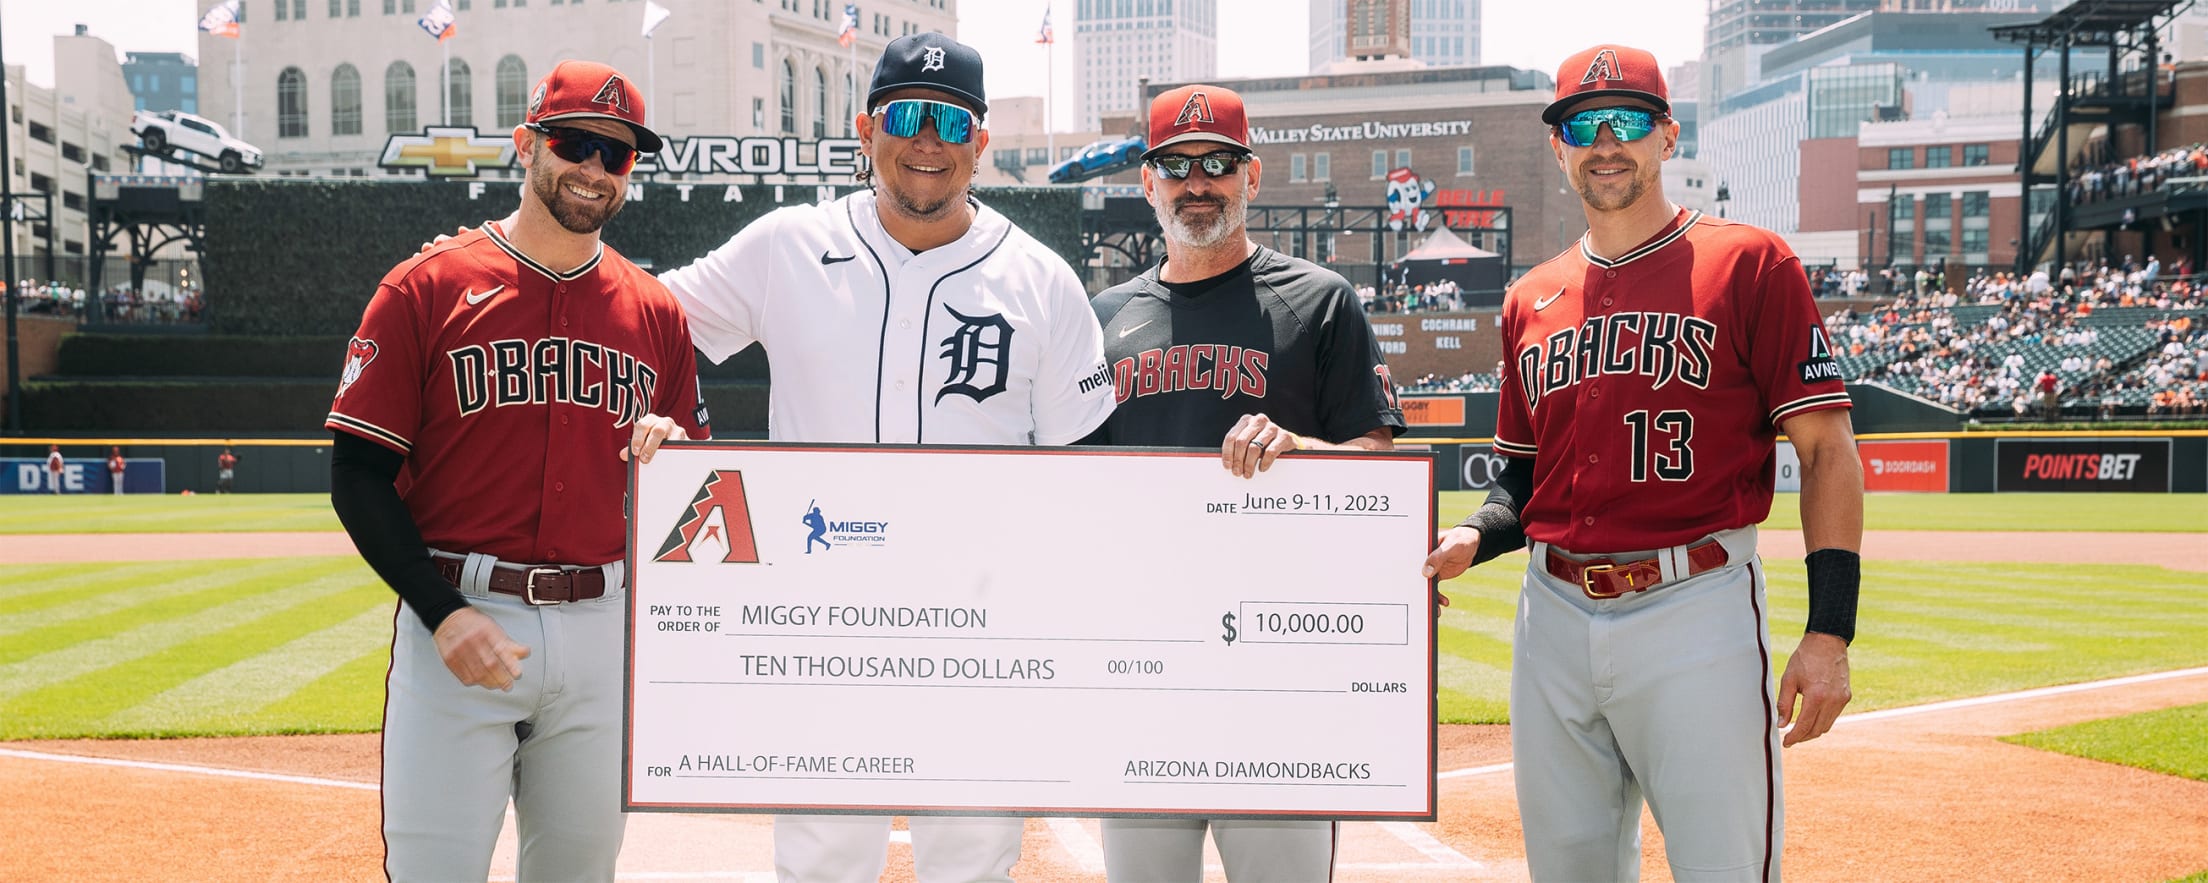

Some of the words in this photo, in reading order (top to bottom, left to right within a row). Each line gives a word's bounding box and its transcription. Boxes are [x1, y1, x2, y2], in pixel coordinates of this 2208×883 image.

[1249, 127, 1309, 144] VALLEY
[1311, 124, 1361, 142] STATE
[1363, 121, 1472, 139] UNIVERSITY
[1443, 210, 1495, 227] TIRE
[1421, 319, 1477, 331] COCHRANE
[1436, 336, 1462, 349] KELL
[1078, 363, 1112, 394] meij
[1805, 362, 1841, 380] AVNE
[1624, 409, 1695, 483] 13
[1206, 502, 1238, 514] DATE
[1241, 492, 1288, 511] June
[1292, 493, 1339, 514] 9-11,
[1343, 494, 1391, 512] 2023
[829, 520, 889, 533] MIGGY
[649, 604, 673, 617] PAY
[675, 605, 693, 617] TO
[695, 605, 721, 618] THE
[741, 604, 822, 627] MIGGY
[827, 605, 988, 629] FOUNDATION
[657, 620, 701, 633] ORDER
[704, 621, 721, 633] OF
[1221, 610, 1238, 647] $
[1255, 612, 1364, 636] 10,000.00
[739, 654, 787, 677] TEN
[792, 655, 936, 679] THOUSAND
[942, 657, 1056, 680] DOLLARS
[1107, 659, 1164, 675] 00/100
[1351, 681, 1408, 694] DOLLARS
[647, 765, 672, 778] FOR
[678, 754, 692, 771] A
[697, 754, 838, 773] HALL-OF-FAME
[842, 756, 915, 774] CAREER
[1124, 759, 1210, 778] ARIZONA
[1215, 761, 1371, 780] DIAMONDBACKS
